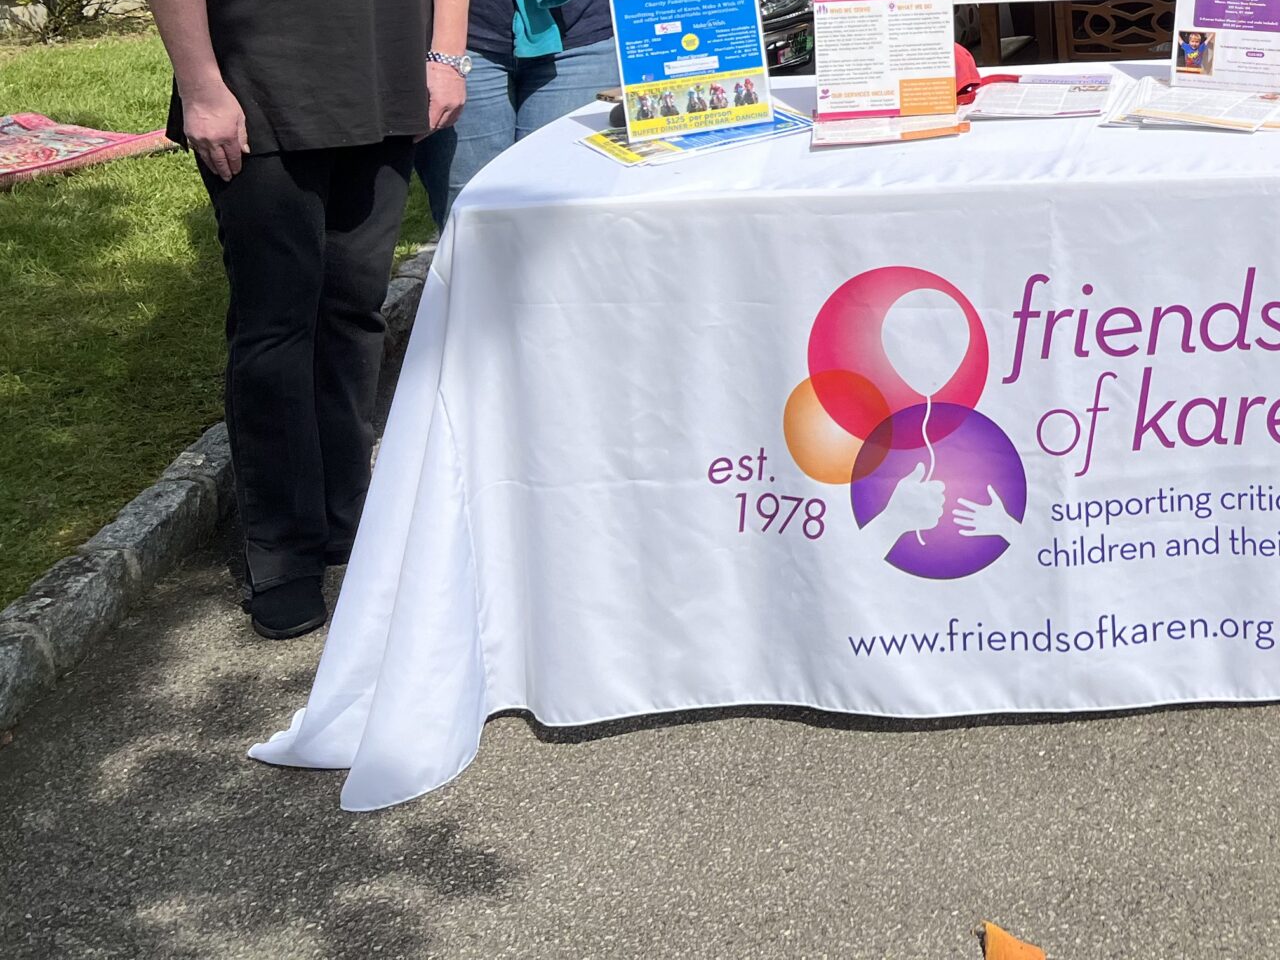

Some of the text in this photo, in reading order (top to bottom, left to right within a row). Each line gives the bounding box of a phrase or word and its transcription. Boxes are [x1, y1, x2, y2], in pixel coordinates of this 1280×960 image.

[632, 127, 658, 137] BUFFET
[660, 123, 688, 132] DINNER
[694, 120, 714, 128] OPEN
[715, 117, 729, 125] BAR
[735, 112, 768, 121] DANCING
[666, 116, 685, 125] $125
[705, 111, 732, 121] person
[1036, 371, 1118, 477] of
[707, 447, 776, 484] est.
[734, 492, 827, 540] 1978
[1050, 487, 1212, 527] supporting
[1037, 534, 1156, 568] children
[1165, 526, 1220, 557] and
[848, 612, 1275, 657] www.friendsofkaren.org
